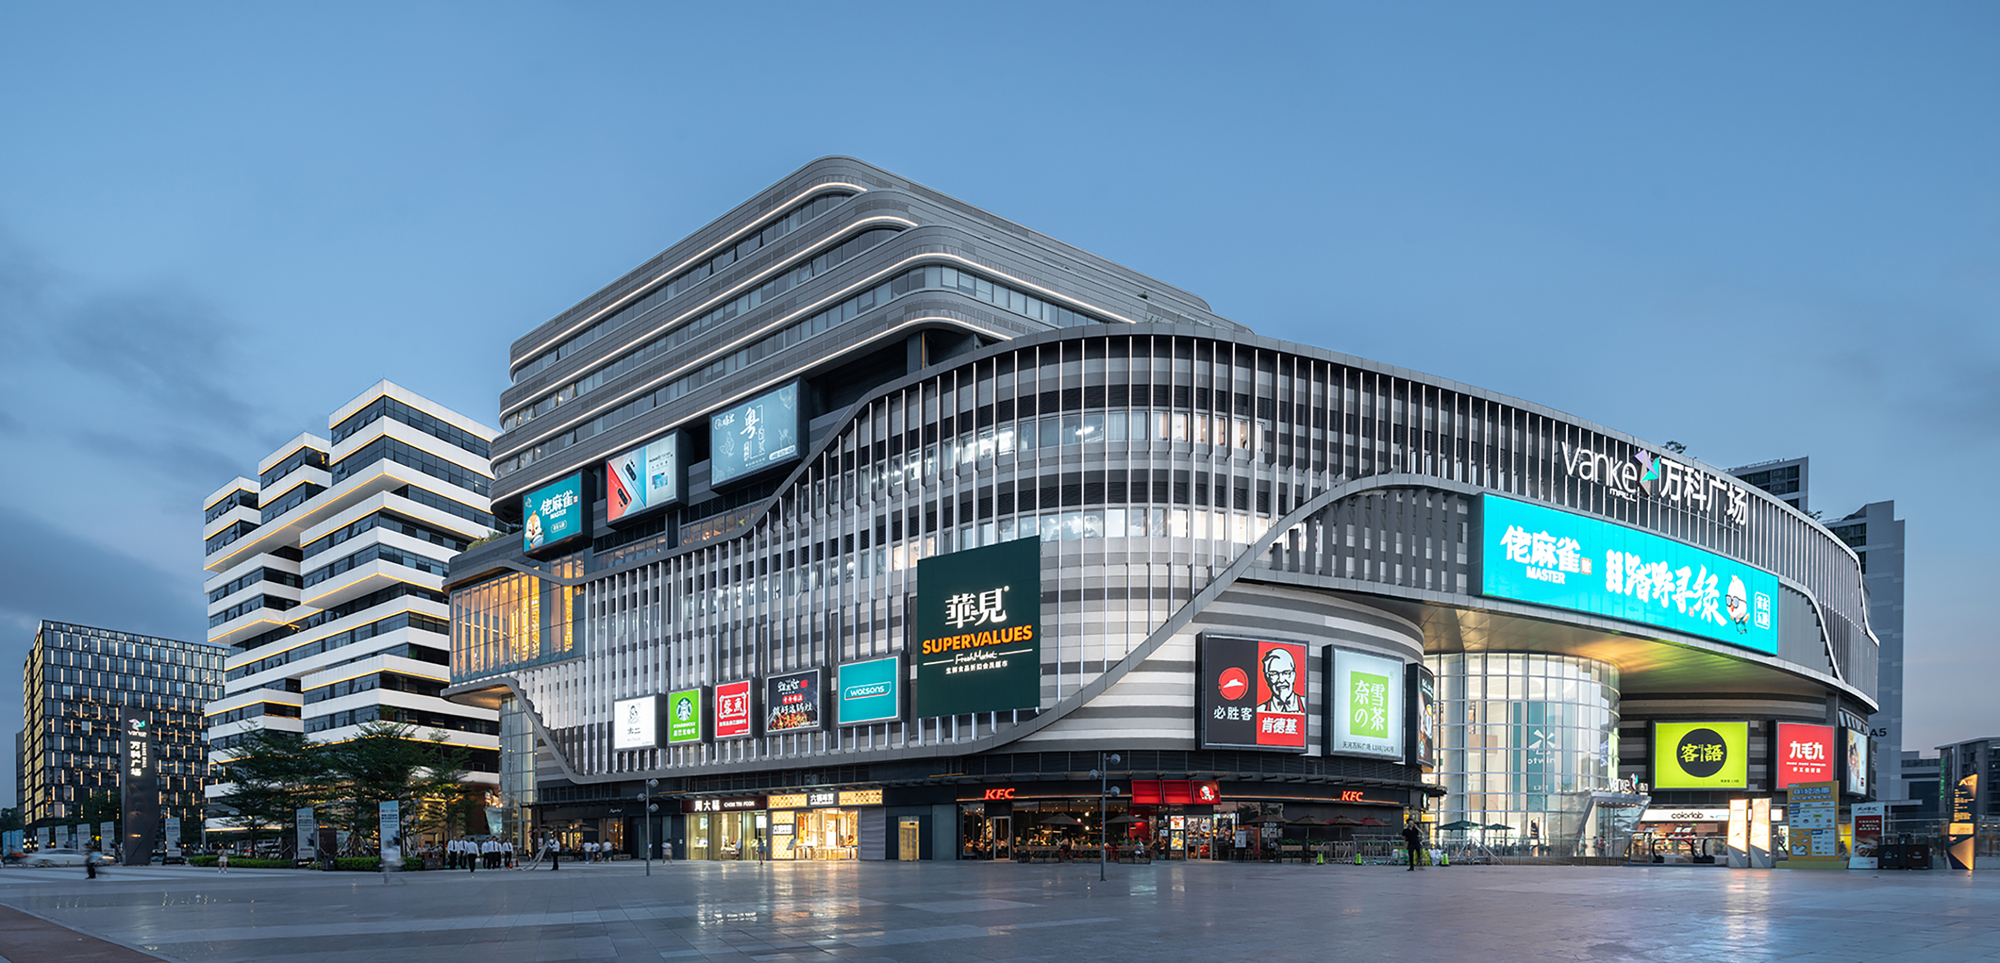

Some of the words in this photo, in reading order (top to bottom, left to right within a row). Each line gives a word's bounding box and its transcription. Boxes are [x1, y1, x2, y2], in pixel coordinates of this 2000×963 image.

[1561, 441, 1638, 493] vanke
[1660, 458, 1747, 526] 万科广场
[1526, 566, 1566, 585] MASTER
[944, 587, 1008, 629] 華見
[921, 624, 1034, 655] SUPERVALUES
[850, 685, 885, 696] watsons
[1213, 705, 1253, 721] 必胜客
[1261, 717, 1297, 735] 肯德基
[1870, 728, 1887, 737] A5
[130, 741, 142, 777] 万科广场
[1789, 740, 1825, 760] 九毛九
[983, 787, 1016, 800] KFC
[1340, 790, 1364, 802] KFC
[694, 799, 720, 812] 周大福
[1671, 811, 1704, 820] colorlab
